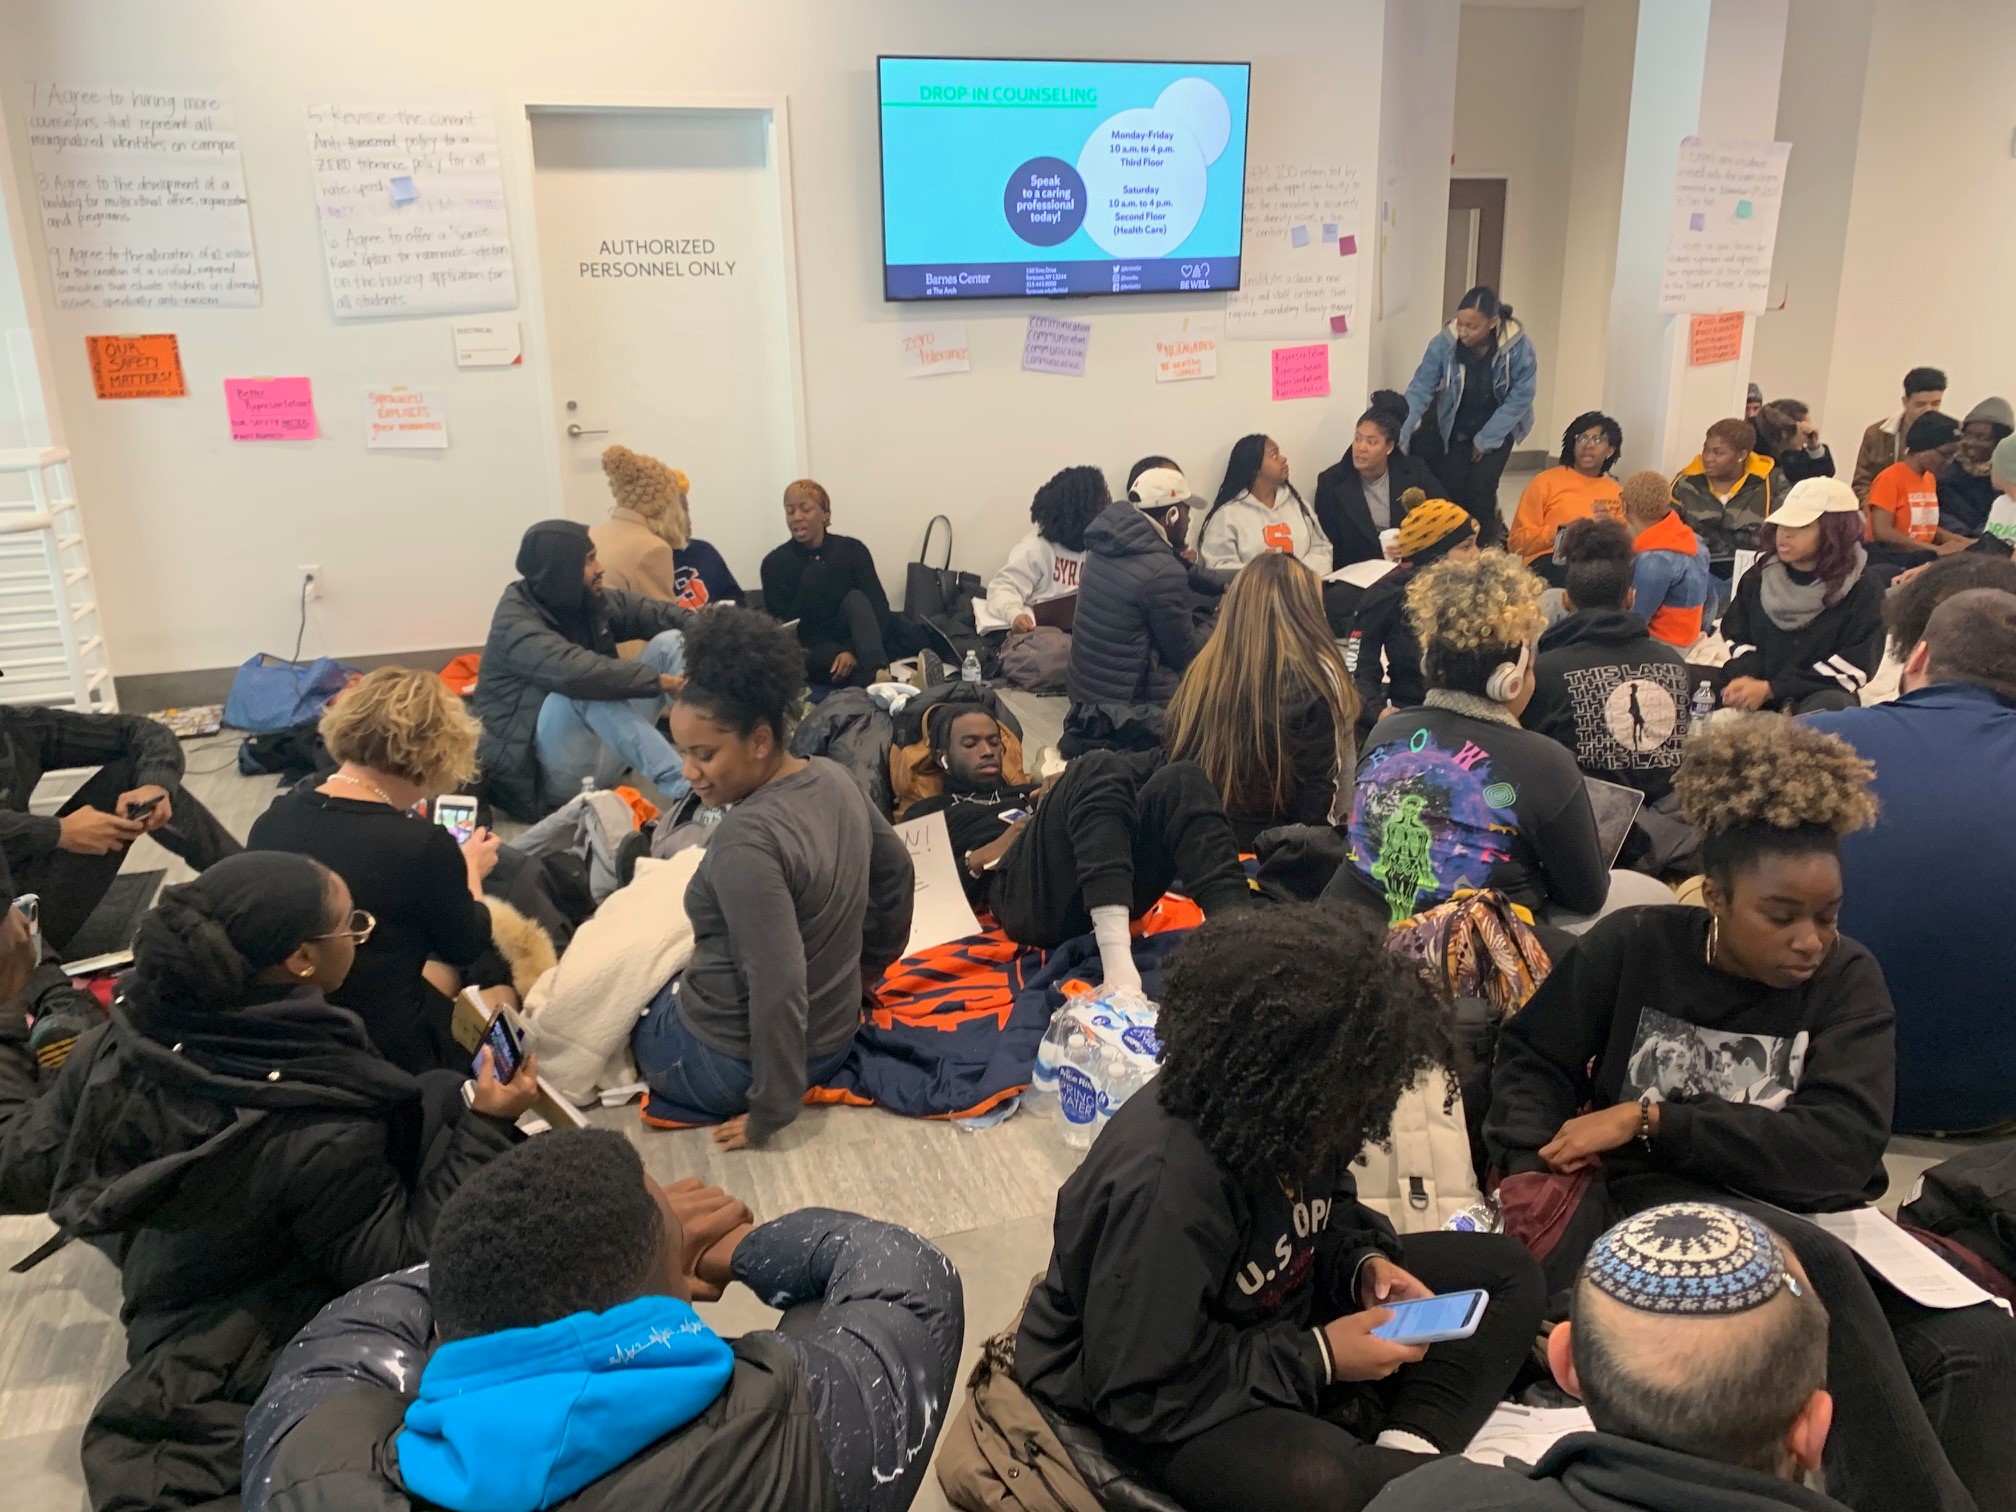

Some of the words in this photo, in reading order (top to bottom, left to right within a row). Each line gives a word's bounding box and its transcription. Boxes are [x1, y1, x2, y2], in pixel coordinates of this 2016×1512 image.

[48, 82, 100, 115] Agree
[108, 89, 123, 105] to
[132, 89, 175, 116] hiring
[184, 96, 220, 111] more
[920, 85, 967, 101] DROP
[972, 86, 988, 101] IN
[992, 87, 1097, 102] COUNSELING
[104, 115, 130, 130] that
[194, 116, 212, 131] all
[1112, 130, 1174, 141] Monday-Friday
[172, 141, 186, 152] on
[1110, 144, 1120, 153] 10
[1151, 144, 1155, 152] 4
[1158, 146, 1175, 155] p.m.
[1121, 157, 1141, 167] Third
[1144, 157, 1163, 167] Floor
[97, 175, 111, 191] to
[114, 176, 134, 191] the
[222, 181, 230, 190] a
[1031, 174, 1060, 189] Speak
[1023, 189, 1033, 199] to
[1034, 190, 1040, 198] a
[1042, 187, 1071, 200] caring
[1123, 185, 1159, 195] Saturday
[1017, 198, 1074, 213] professional
[1109, 199, 1119, 208] 10
[1149, 199, 1154, 207] 4
[1156, 200, 1173, 209] p.m.
[1031, 211, 1060, 224] today!
[1115, 212, 1144, 221] Second
[1146, 212, 1166, 221] Floor
[1114, 225, 1143, 236] (Health
[1145, 224, 1166, 235] Care)
[600, 240, 715, 255] AUTHORIZED
[580, 262, 685, 278] PERSONNEL
[689, 261, 735, 276] ONLY
[926, 273, 957, 285] Barnes
[959, 272, 990, 284] Center
[1180, 280, 1189, 289] BE
[1190, 279, 1210, 289] WELL
[933, 287, 943, 295] The
[106, 342, 144, 357] OUR
[108, 357, 158, 373] SAFETY
[110, 372, 171, 388] MATTERS!
[1564, 665, 1621, 685] THIS
[1622, 662, 1687, 678] LAND
[1578, 754, 1630, 770] THIS
[1632, 752, 1683, 770] LAN
